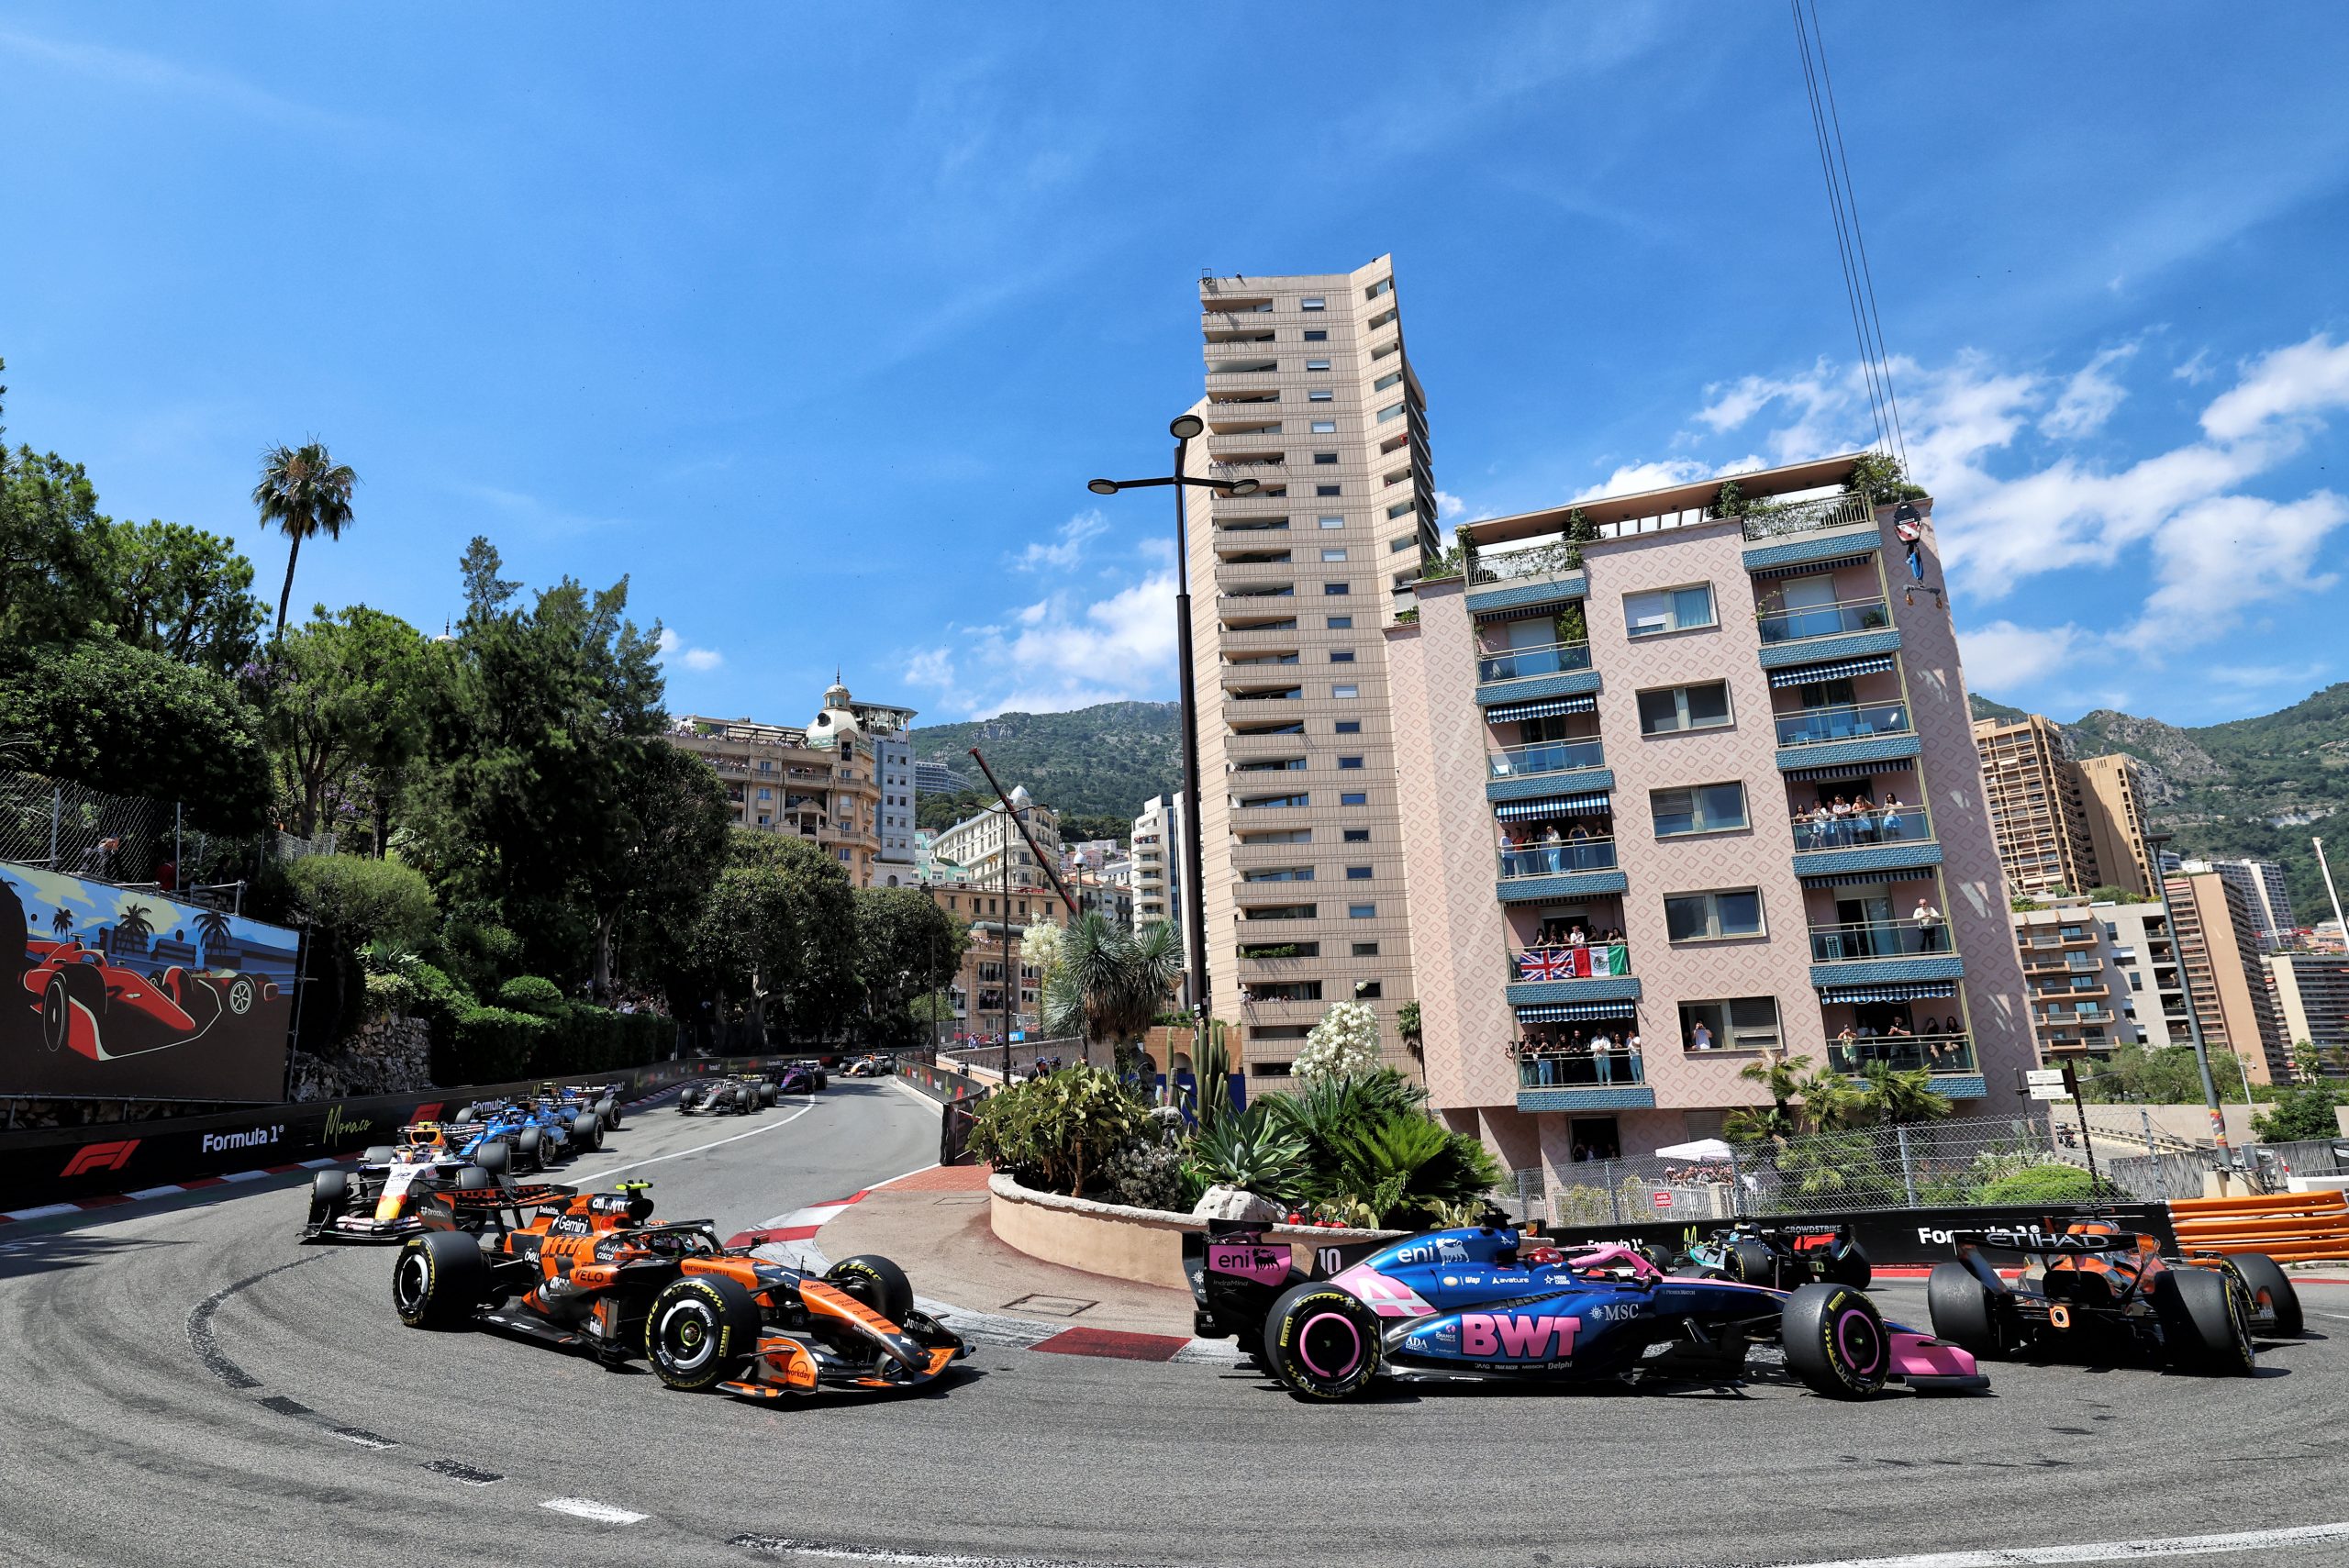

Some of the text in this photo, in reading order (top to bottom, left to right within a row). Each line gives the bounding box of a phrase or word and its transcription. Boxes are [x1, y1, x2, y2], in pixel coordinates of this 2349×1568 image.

[323, 1104, 373, 1147] Monaco
[202, 1128, 268, 1153] Formula
[558, 1215, 589, 1234] Gemini
[1785, 1225, 1842, 1234] CROWDSTRIKE
[1986, 1232, 2110, 1249] ETIHAD
[524, 1251, 540, 1263] DELL
[1218, 1250, 1250, 1269] eni
[1318, 1248, 1341, 1275] 10
[1397, 1241, 1434, 1263] eni
[574, 1270, 604, 1283] VELO
[684, 1265, 731, 1277] RICHARD MILLE
[850, 1262, 883, 1281] ZERO
[698, 1306, 713, 1327] Gemini
[1604, 1304, 1639, 1321] MSC
[589, 1316, 603, 1337] intel
[1461, 1313, 1583, 1359] BWT
[1405, 1336, 1429, 1349] ADA
[785, 1369, 811, 1381] workday
[1547, 1361, 1573, 1371] Delphi
